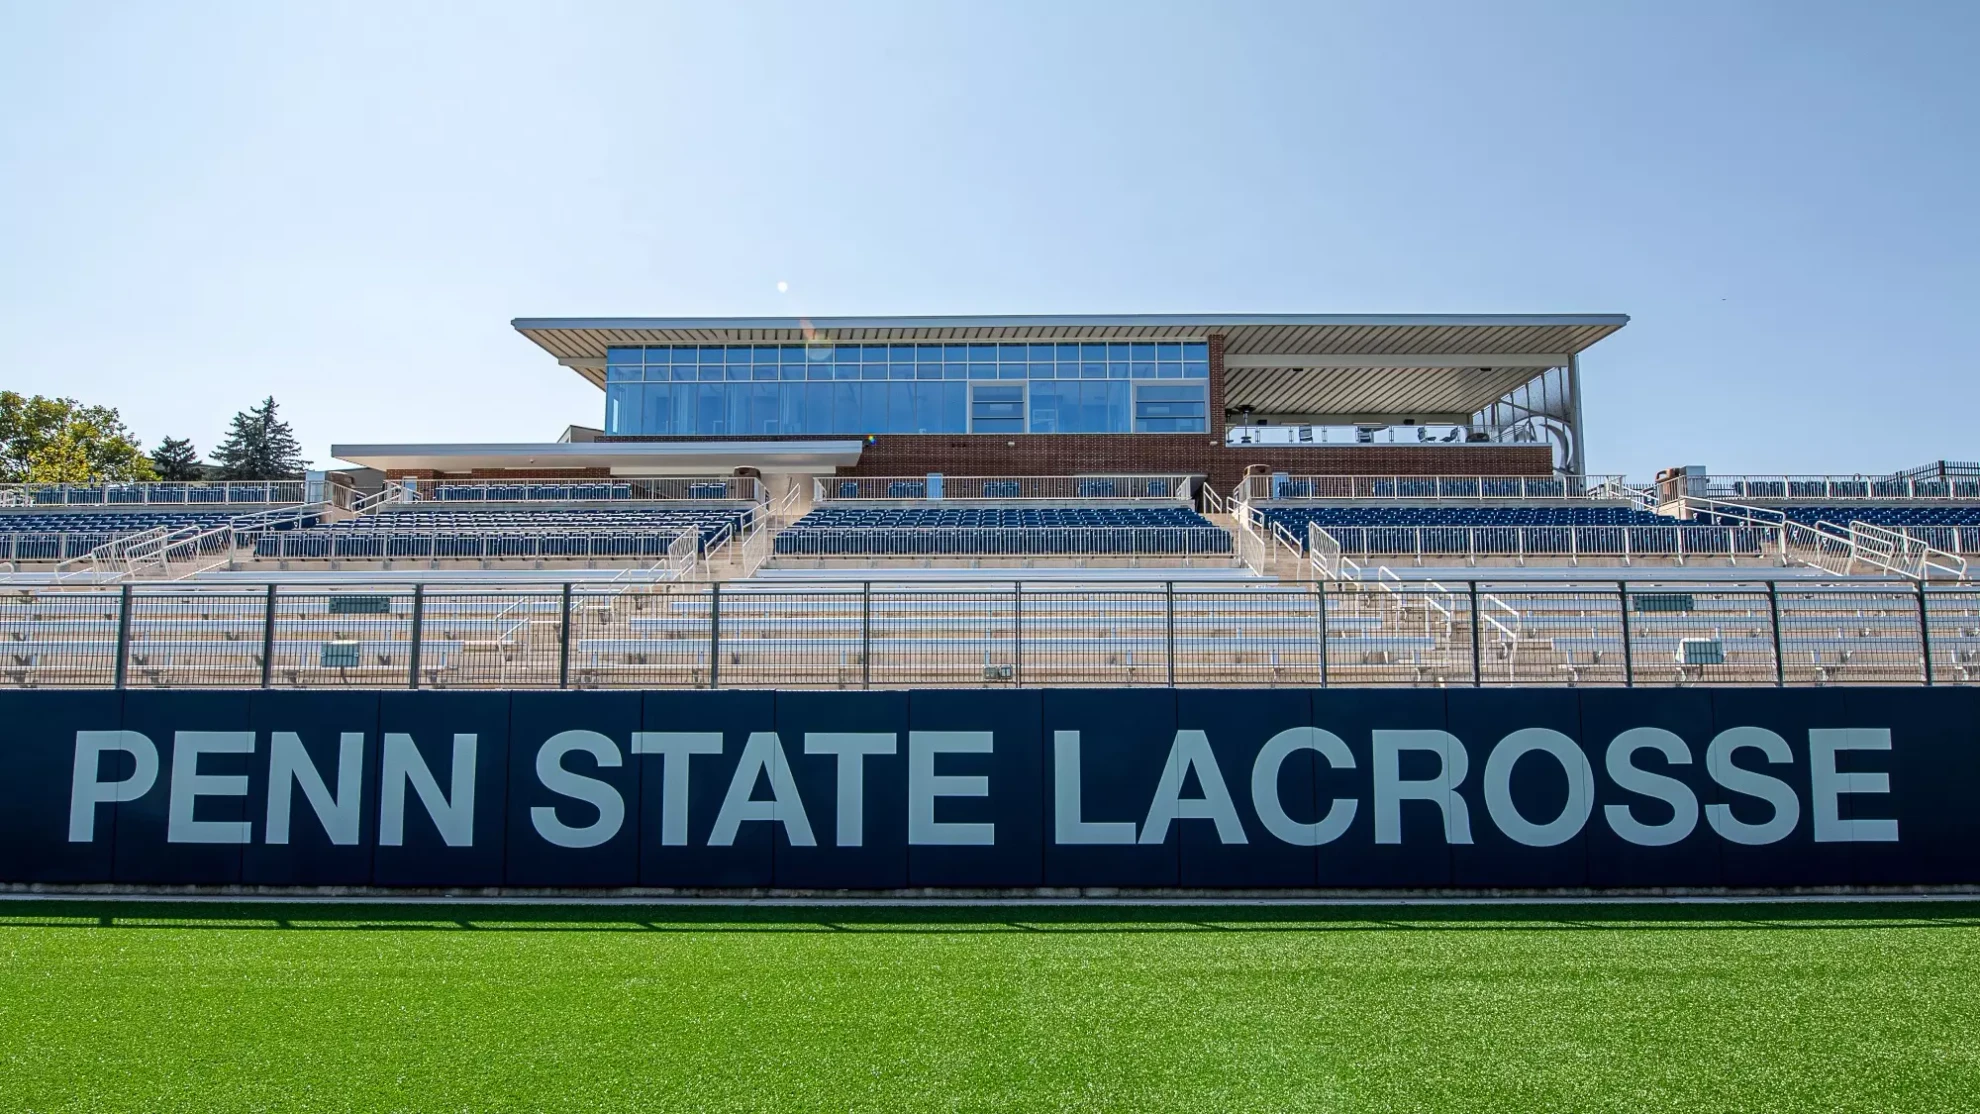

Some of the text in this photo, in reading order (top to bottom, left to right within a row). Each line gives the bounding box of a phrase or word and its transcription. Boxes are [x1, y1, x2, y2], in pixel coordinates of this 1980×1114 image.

[67, 727, 1899, 847] PENN STATE LACROSSE
